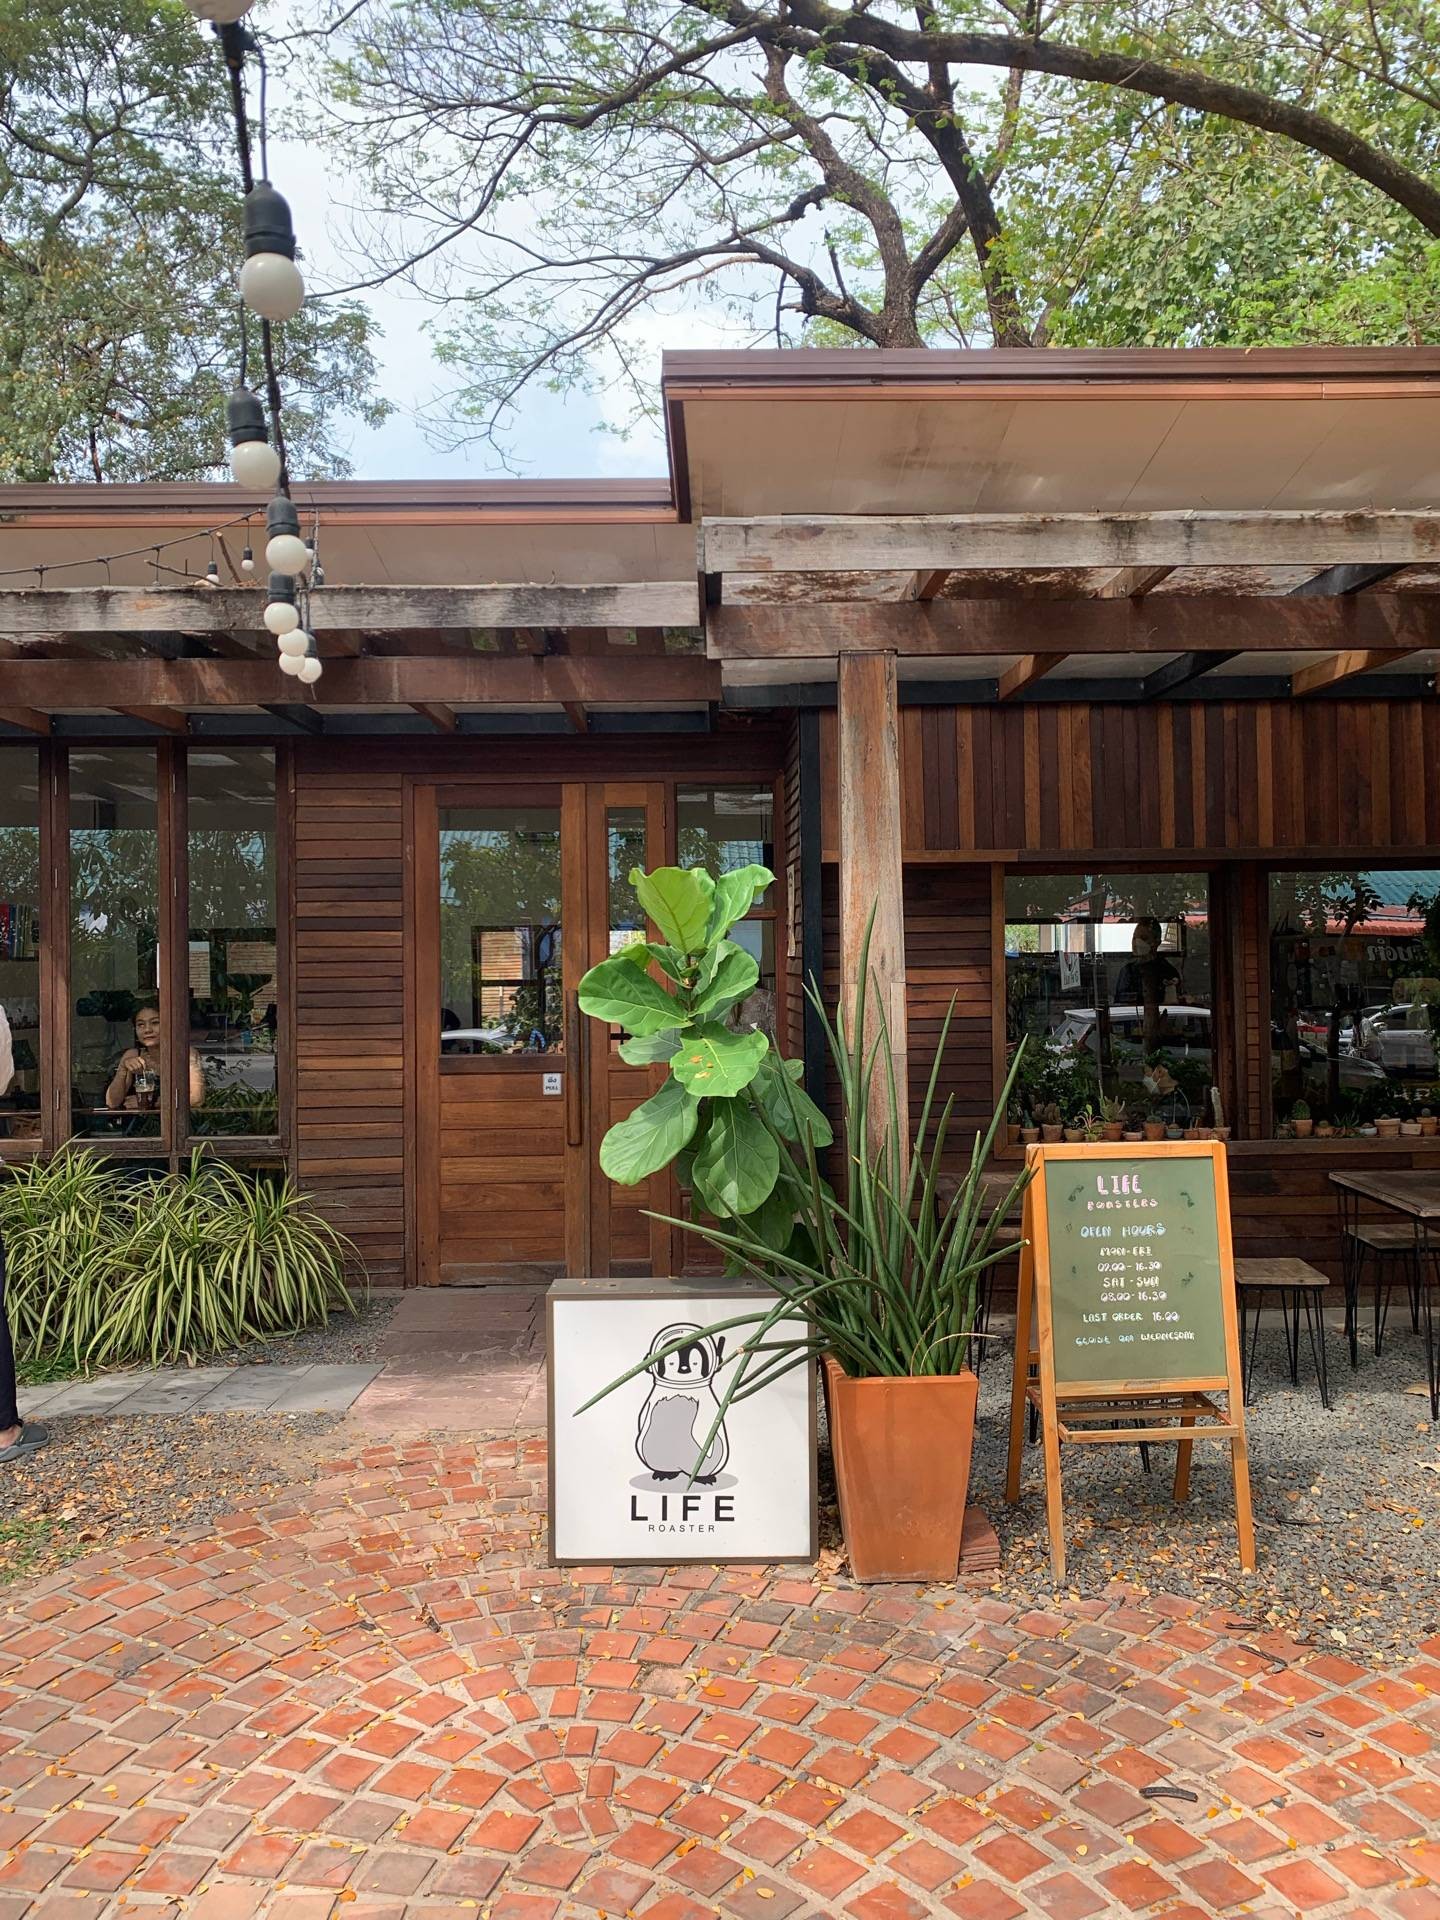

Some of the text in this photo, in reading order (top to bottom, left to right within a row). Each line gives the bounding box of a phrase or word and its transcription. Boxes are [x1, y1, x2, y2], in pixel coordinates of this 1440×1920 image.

[1096, 1174, 1143, 1195] LIFE
[1122, 1222, 1167, 1238] HOURS
[1103, 1277, 1125, 1288] SAT
[1136, 1276, 1160, 1288] SUN
[1082, 1311, 1180, 1323] LAST ORDER 16.00
[631, 1495, 735, 1521] LIFE
[648, 1524, 715, 1533] ROASTER
